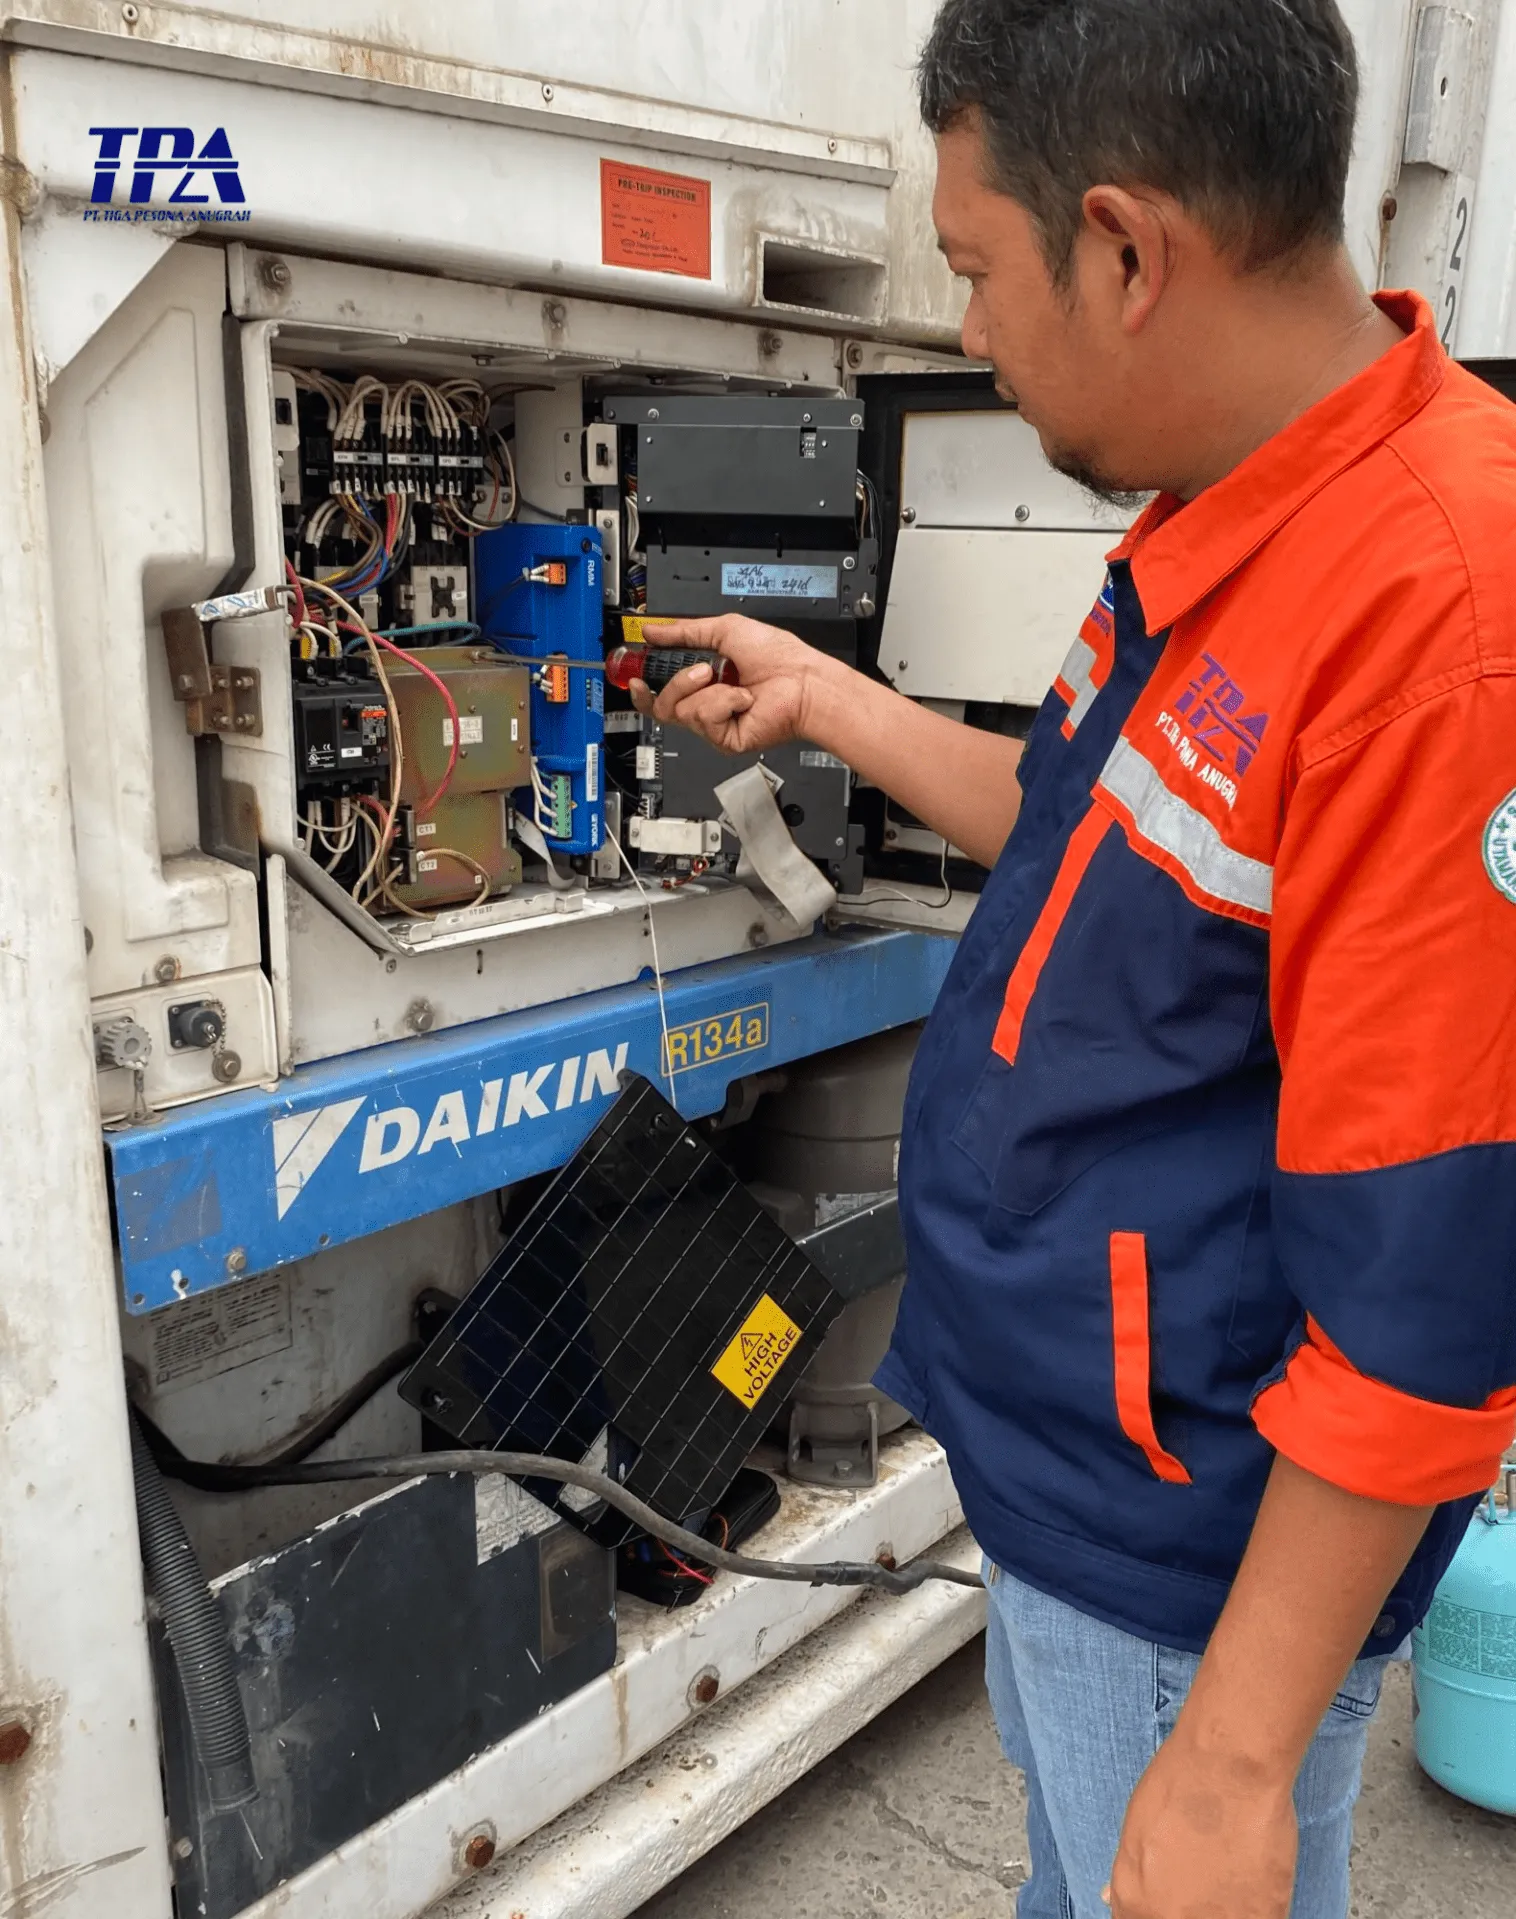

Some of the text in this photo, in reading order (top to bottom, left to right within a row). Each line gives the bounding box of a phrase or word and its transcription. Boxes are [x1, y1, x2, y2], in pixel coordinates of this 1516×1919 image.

[618, 178, 696, 202] PRE-TRIP INSPECTION
[1174, 651, 1269, 778] TPA
[1197, 762, 1238, 812] ANUGRA
[419, 825, 433, 834] CT1
[420, 861, 435, 870] CT2
[668, 1014, 762, 1070] R134a
[359, 1041, 629, 1174] DAIKIN
[743, 1326, 797, 1400] VOLTAGE
[744, 1331, 777, 1377] HIGH
